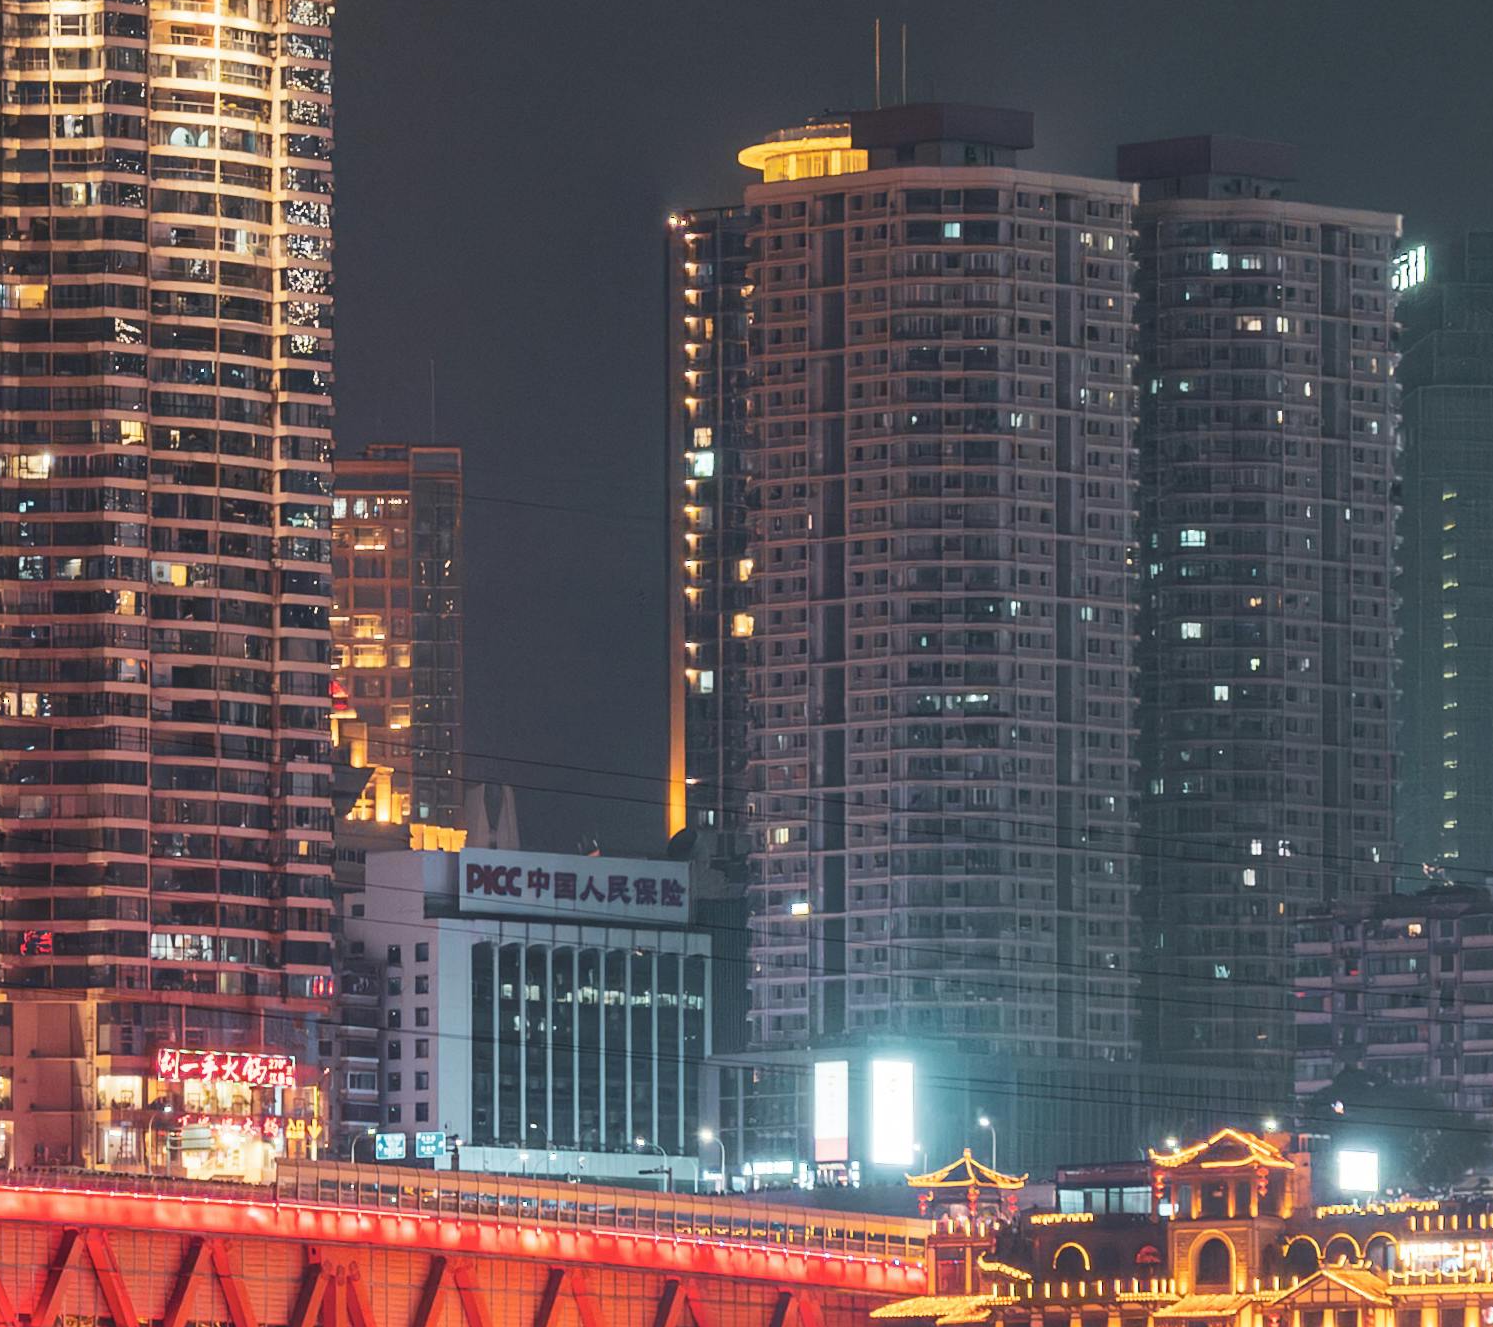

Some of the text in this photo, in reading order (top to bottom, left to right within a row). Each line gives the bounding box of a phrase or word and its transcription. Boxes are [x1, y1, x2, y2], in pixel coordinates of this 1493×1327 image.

[466, 863, 686, 908] PICC 中国人民保险
